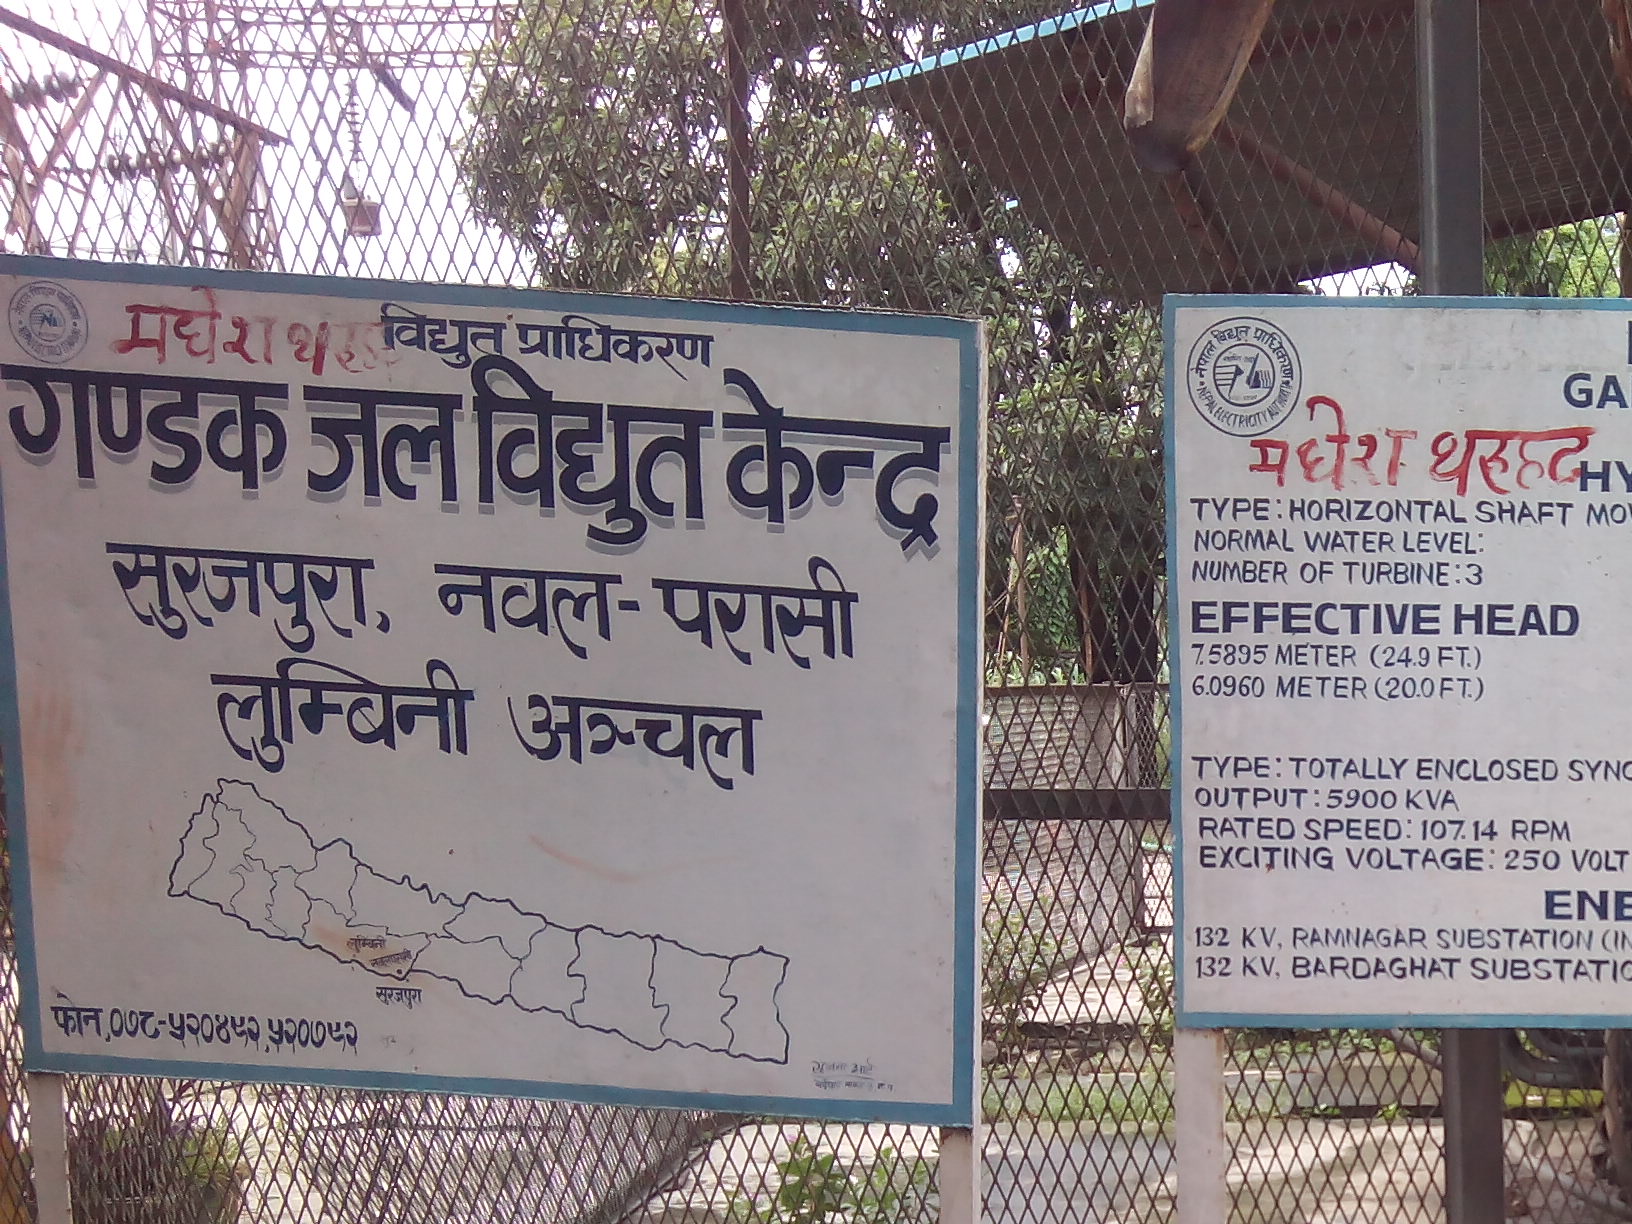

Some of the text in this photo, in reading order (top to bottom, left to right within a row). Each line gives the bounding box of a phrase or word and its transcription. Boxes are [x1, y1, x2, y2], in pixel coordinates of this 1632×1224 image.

[516, 315, 715, 381] प्राधिकरण
[0, 355, 951, 553] गण्डक जल विद्युत केन्द्र
[1289, 498, 1468, 523] HORIZONTAL
[1474, 501, 1574, 526] SHAFT
[1193, 528, 1485, 554] NORMAL WATER LEVEL:
[1191, 560, 1334, 585] NUMBER OF
[652, 555, 859, 669] परासी
[1191, 601, 1580, 637] EFFECTIVE HEAD
[1275, 642, 1357, 668] METER
[1192, 674, 1266, 699] 6.0960
[1275, 675, 1368, 700] METER
[210, 657, 475, 773] लुम्बिनी
[1288, 756, 1409, 781] TOTALLY
[1416, 757, 1560, 782] ENCLOSED
[1325, 788, 1398, 811] 5900
[1404, 788, 1460, 812] KVA
[1199, 816, 1296, 841] RATED
[1511, 819, 1573, 843] RPM
[1199, 844, 1335, 872] EXCITING
[1503, 848, 1561, 872] 250
[1571, 848, 1631, 873] VOLT
[1195, 926, 1231, 948] 132
[1292, 927, 1429, 949] RAMNAGAR
[1435, 927, 1594, 951] SUBSTATION
[1195, 956, 1232, 979] 132
[1291, 956, 1462, 980] BARDAGHAT
